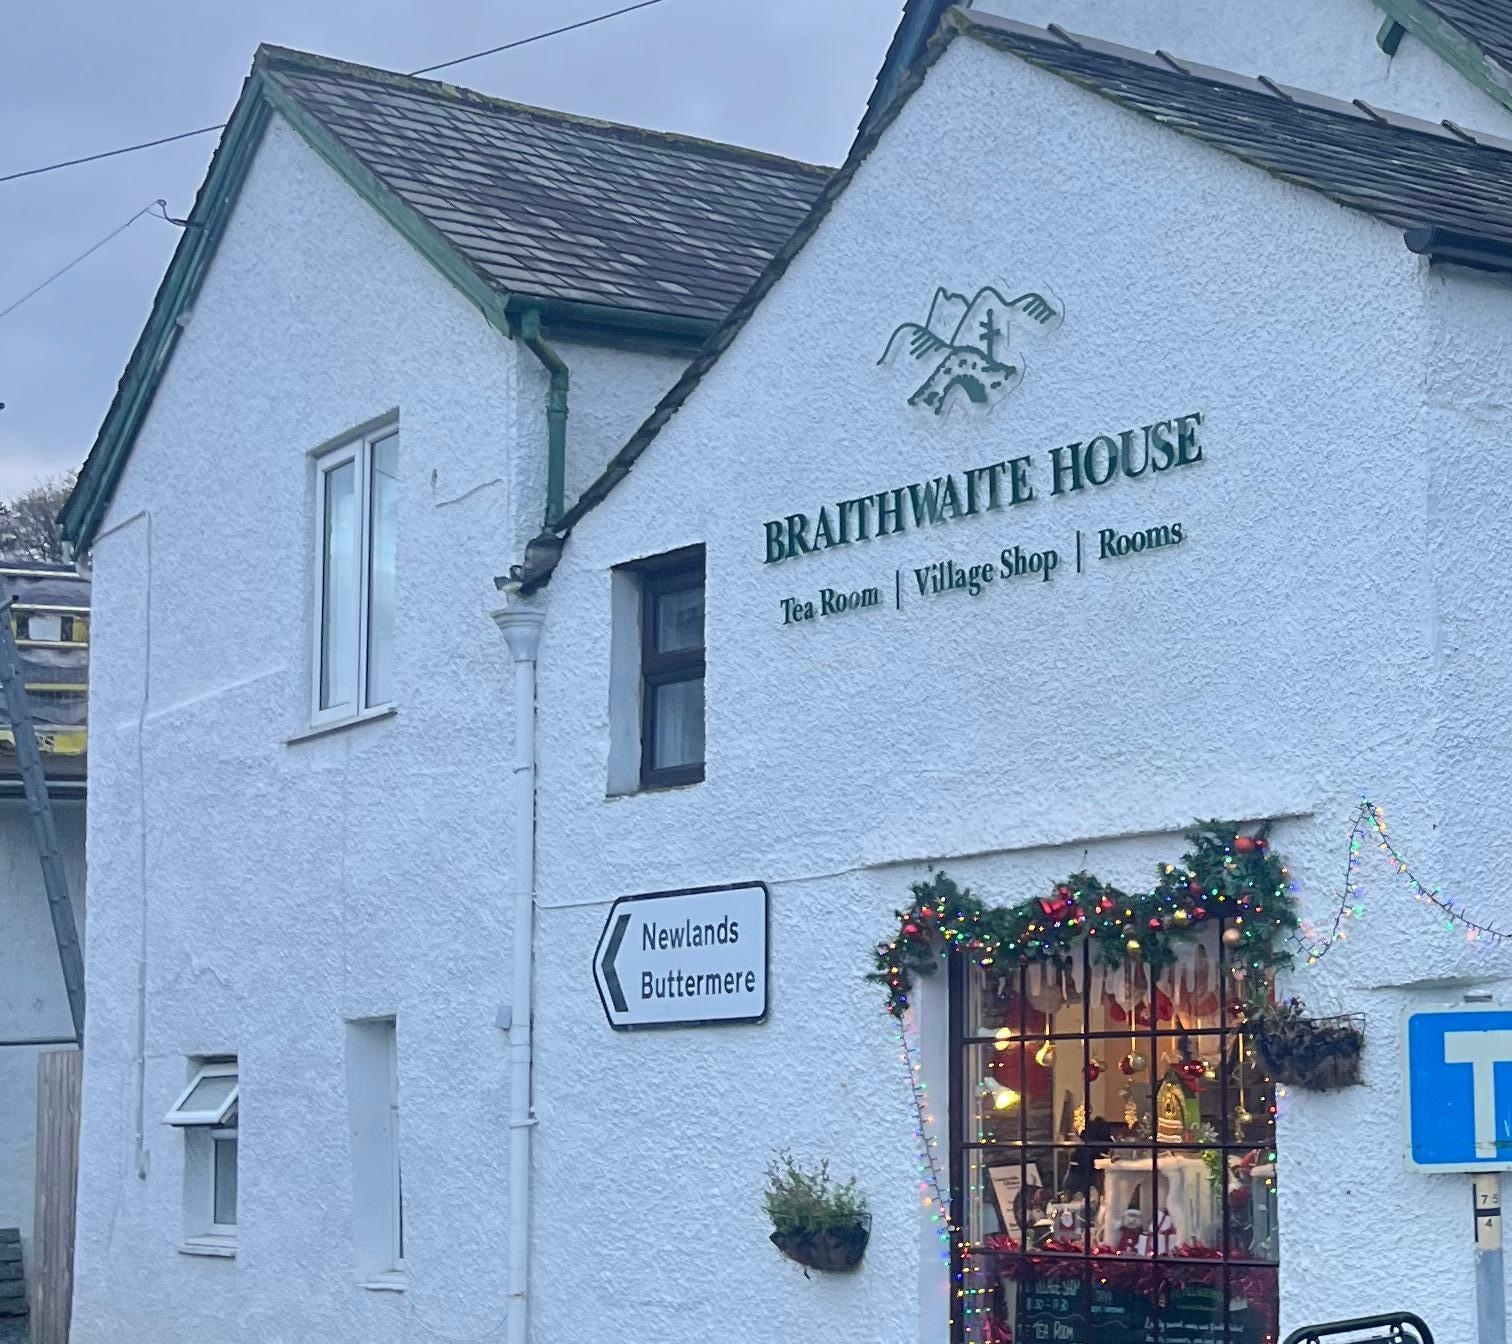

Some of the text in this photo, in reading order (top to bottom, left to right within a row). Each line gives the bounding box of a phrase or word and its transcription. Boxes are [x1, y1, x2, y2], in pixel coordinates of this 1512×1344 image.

[763, 412, 1204, 565] BRAITHWAITE HOUSE
[780, 522, 1183, 625] Tea Room Village Shop Rooms
[642, 914, 739, 951] Newlands
[641, 969, 756, 999] Buttermere
